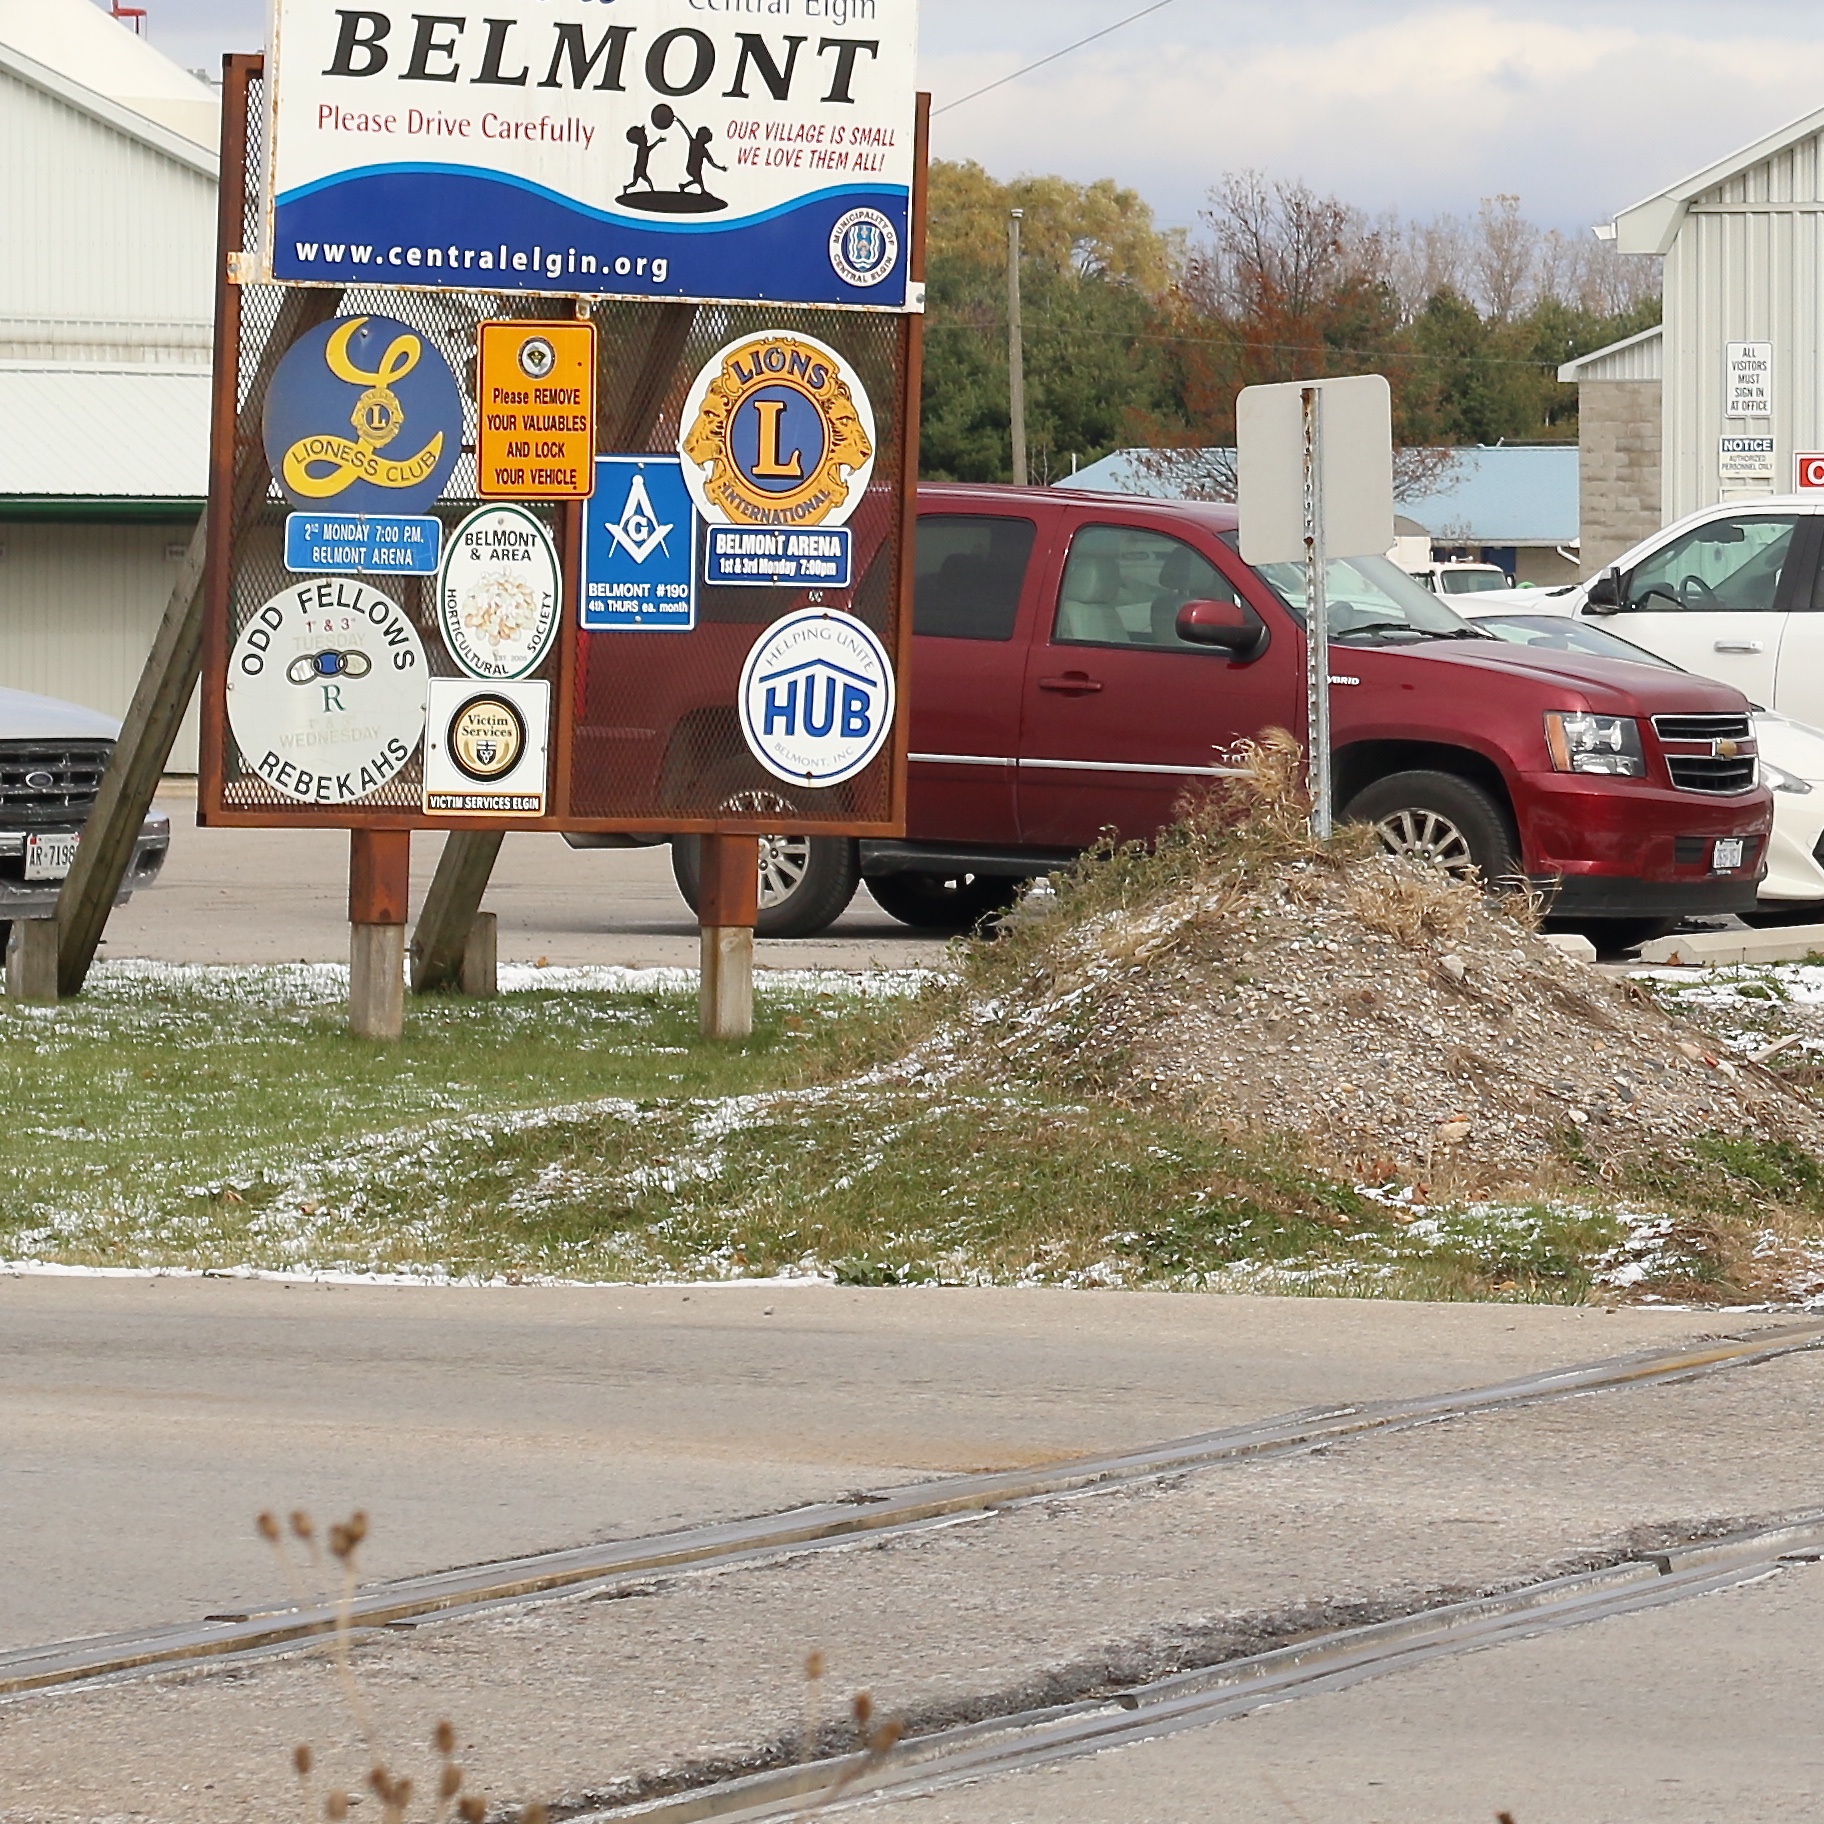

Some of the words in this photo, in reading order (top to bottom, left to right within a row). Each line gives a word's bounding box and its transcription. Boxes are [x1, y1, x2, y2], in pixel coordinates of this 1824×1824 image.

[321, 8, 879, 105] BELMONT
[317, 104, 397, 134] Please
[407, 108, 472, 139] Drive
[480, 111, 596, 152] Carefully
[726, 120, 761, 140] OUR
[765, 121, 825, 144] VILLAGE
[829, 126, 846, 145] IS
[849, 127, 896, 147] SMALL
[737, 147, 760, 166] WE
[764, 148, 803, 168] LOVE
[809, 149, 848, 170] THEM
[852, 152, 885, 172] ALL!
[832, 210, 890, 245] MUNICIPALITY
[885, 231, 896, 246] OF
[295, 240, 671, 283] www.centralelgin.org
[832, 253, 868, 284] CENTRAL
[870, 256, 893, 282] ELGIN
[1742, 348, 1756, 358] ALL
[731, 347, 828, 390] LIONS
[1731, 361, 1767, 371] VISITORS
[1738, 374, 1760, 384] MUST
[493, 388, 529, 405] Please
[534, 389, 580, 405] REMOVE
[1735, 388, 1752, 398] SIGN
[1756, 388, 1764, 398] IN
[1731, 401, 1739, 411] AT
[1742, 401, 1768, 411] OFFICE
[487, 415, 517, 431] YOUR
[522, 415, 587, 432] VALUABLES
[752, 400, 803, 478] L
[1723, 439, 1771, 451] NOTICE
[507, 442, 530, 458] AND
[535, 442, 565, 458] LOCK
[291, 439, 379, 478] LIONESS
[385, 450, 438, 483] CLUB
[495, 468, 524, 485] YOUR
[530, 469, 577, 486] VEHICLE
[721, 485, 831, 524] INTERNATIONAL
[323, 523, 369, 542] MONDAY
[375, 525, 398, 542] 7:00
[403, 526, 424, 543] P.M.
[627, 514, 648, 542] G
[465, 530, 538, 547] BELMONT
[716, 534, 785, 555] BELMONT
[787, 536, 841, 556] ARENA
[312, 546, 367, 564] BELMONT
[372, 548, 413, 566] ARENA
[470, 548, 481, 561] &
[490, 549, 532, 561] AREA
[719, 557, 733, 573] 1st
[734, 559, 741, 573] &
[742, 558, 757, 573] 3rd
[758, 559, 796, 576] Monday
[800, 559, 836, 576] 7:00pm
[589, 583, 651, 597] BELMONT
[656, 584, 688, 598] #190
[588, 600, 604, 612] 4th
[607, 600, 638, 612] THURS
[659, 601, 688, 613] month
[241, 606, 283, 675] ODD
[297, 583, 415, 671] FELLOWS
[323, 619, 334, 632] &
[447, 589, 509, 675] HORTICULTURAL
[527, 591, 551, 653] SOCIETY
[292, 633, 366, 651] TUESDAY
[766, 627, 832, 667] HELPING
[837, 633, 874, 672] UNITE
[321, 684, 345, 712] R
[763, 673, 871, 738] HUB
[468, 714, 508, 725] Victim
[279, 727, 380, 749] WEDNESDAY
[462, 726, 512, 737] Services
[258, 738, 408, 800] REBEKAHS
[430, 796, 462, 809] VICTIM
[464, 796, 511, 809] SERVICES
[513, 797, 539, 810] ELGIN
[30, 846, 42, 866] AR
